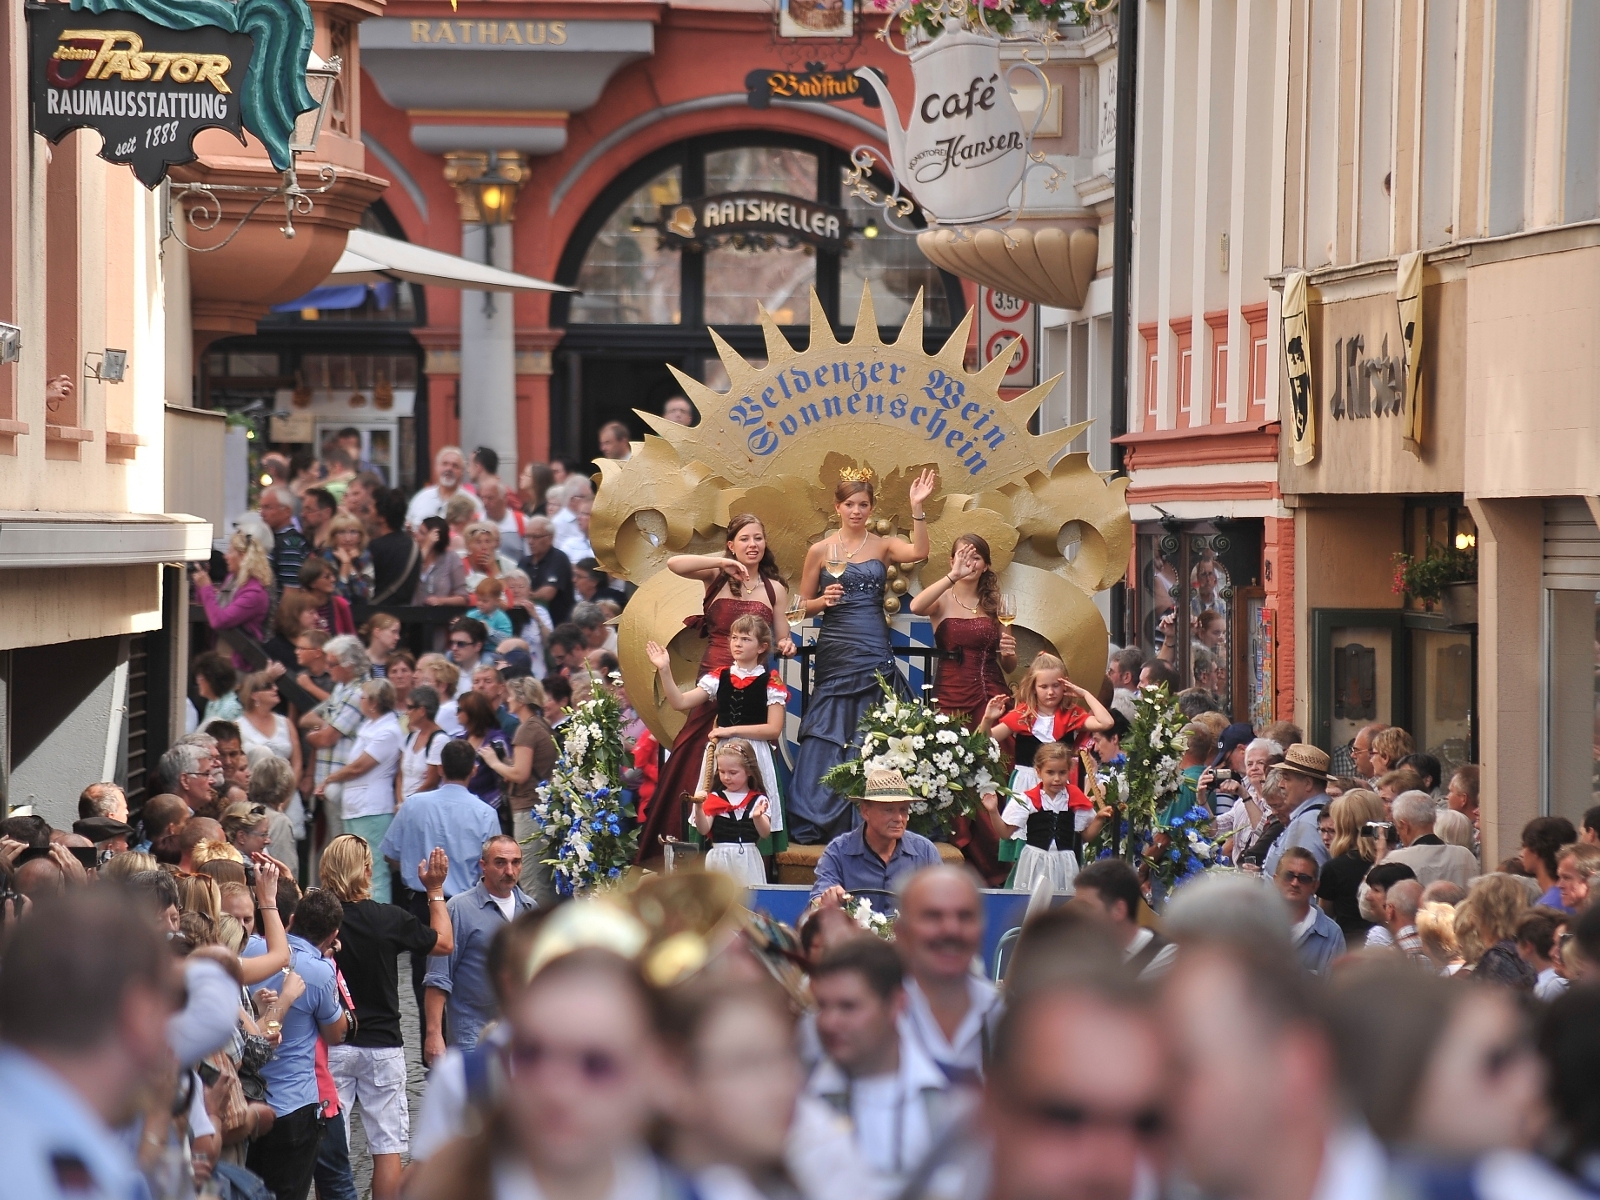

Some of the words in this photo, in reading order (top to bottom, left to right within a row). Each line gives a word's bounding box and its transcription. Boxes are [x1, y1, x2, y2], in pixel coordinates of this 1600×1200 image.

[410, 20, 568, 46] RATHAUS
[47, 88, 227, 120] RAUMAUSSTATTUNG
[920, 73, 999, 124] Café
[115, 136, 138, 157] seit
[145, 121, 179, 149] 1888
[916, 131, 1024, 183] Hansen
[705, 199, 839, 239] RATSKELLER
[728, 360, 906, 430] Veldenzer
[920, 369, 1006, 450] Wein
[747, 393, 988, 476] Sonnenschein
